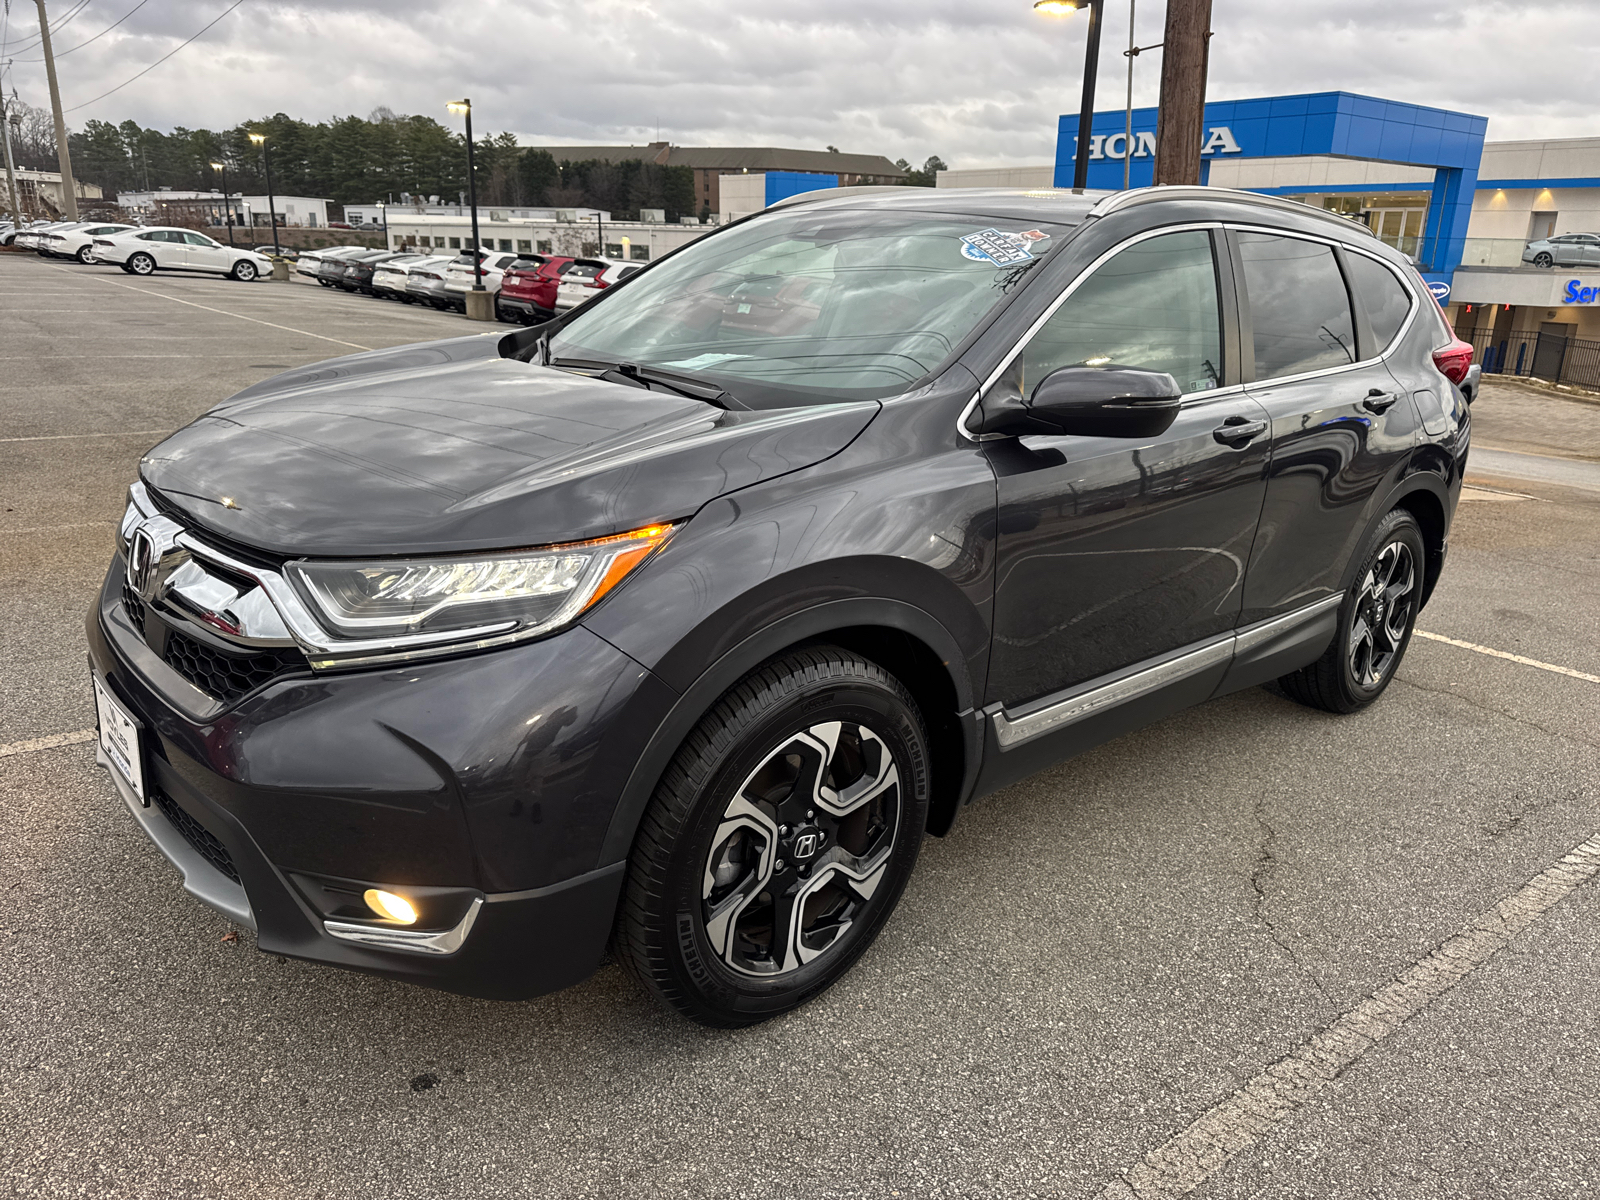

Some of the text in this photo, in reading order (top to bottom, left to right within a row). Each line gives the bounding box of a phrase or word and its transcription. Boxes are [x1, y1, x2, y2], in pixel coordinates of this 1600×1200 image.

[1072, 126, 1243, 160] HONA
[973, 240, 1011, 263] OWNER
[981, 231, 1023, 259] CARFAX
[901, 724, 927, 797] MICHELIN
[679, 919, 719, 997] MICHELIN
